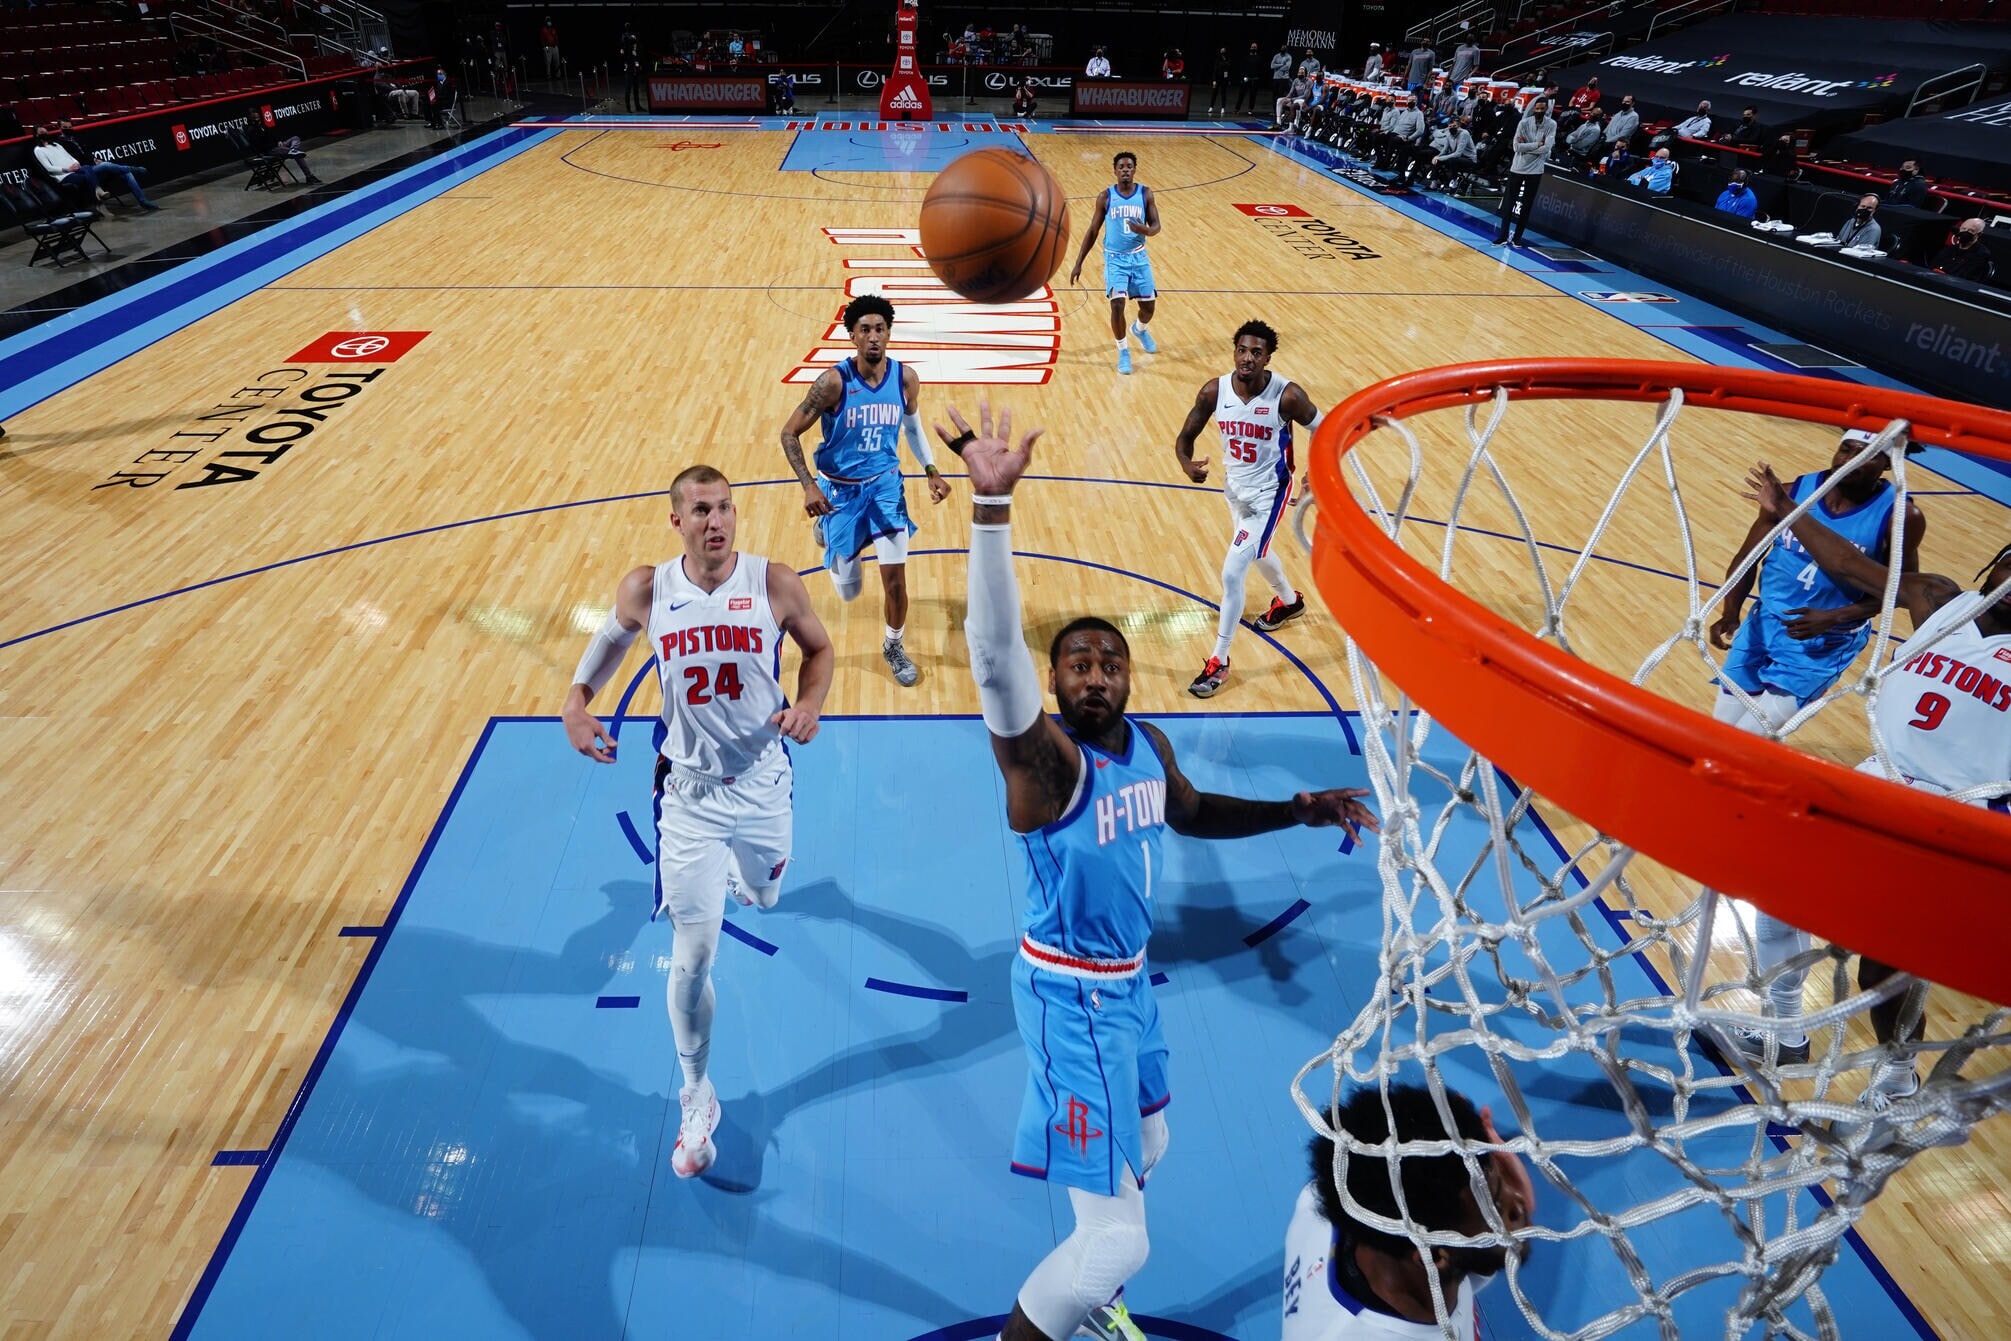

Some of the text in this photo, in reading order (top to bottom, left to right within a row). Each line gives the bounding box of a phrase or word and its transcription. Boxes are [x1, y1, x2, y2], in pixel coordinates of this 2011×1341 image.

[1286, 37, 1336, 49] HERMANN
[1288, 28, 1337, 42] MEMORIAL
[1599, 55, 1707, 75] reliant
[651, 82, 761, 102] WHATABURGER
[881, 74, 948, 85] LUS
[1009, 76, 1072, 87] LXUS
[1725, 70, 1855, 97] reliant
[273, 99, 322, 120] TOYOTA CENTER
[889, 100, 923, 109] adidas
[1077, 87, 1185, 107] WHATABURGER
[188, 116, 249, 141] TOYOTA CENTER
[784, 121, 1031, 134] HOUSTON
[115, 138, 157, 158] CENTER
[1110, 205, 1143, 219] H-TOWN
[1254, 217, 1336, 262] CENTER
[1293, 219, 1383, 261] TOYOTA
[1755, 267, 1820, 305] Houston
[1822, 288, 1893, 331] Rockets
[1904, 322, 2001, 373] reliant
[846, 403, 900, 428] H-TOWN
[91, 367, 308, 491] CENTER
[174, 367, 387, 491] TOYOTA
[857, 426, 883, 452] 35
[1217, 421, 1274, 441] PISTONS
[1229, 438, 1257, 464] 55
[1796, 559, 1820, 591] 4
[660, 624, 763, 662] PISTONS
[683, 662, 744, 706] 24
[1908, 691, 1951, 731] 9
[1095, 780, 1167, 847] H-TOW
[1141, 840, 1151, 898] 1
[1284, 1254, 1301, 1319] BEY
